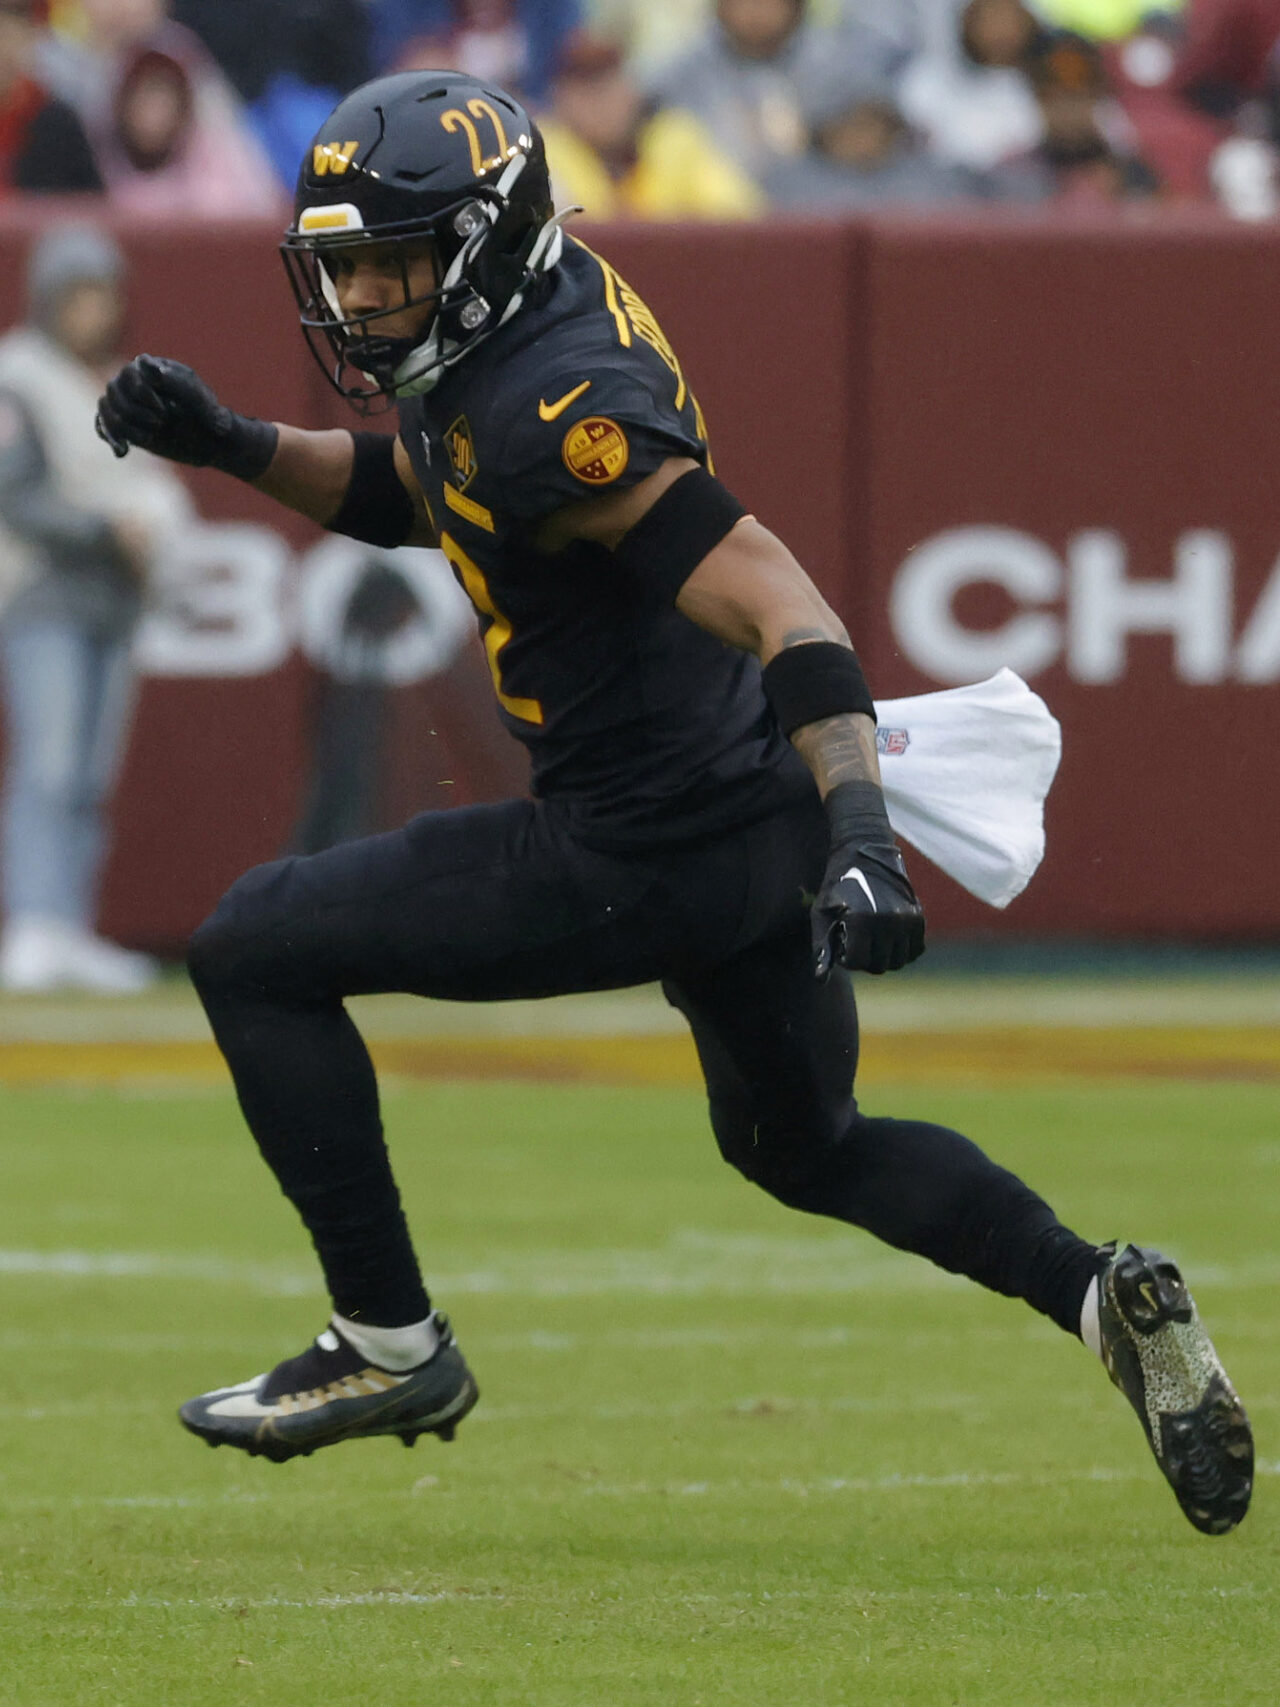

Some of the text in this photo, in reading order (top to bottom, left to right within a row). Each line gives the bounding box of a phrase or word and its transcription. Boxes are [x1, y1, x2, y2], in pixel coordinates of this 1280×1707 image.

[314, 141, 360, 176] W
[440, 99, 520, 176] 22
[890, 525, 1280, 688] CH
